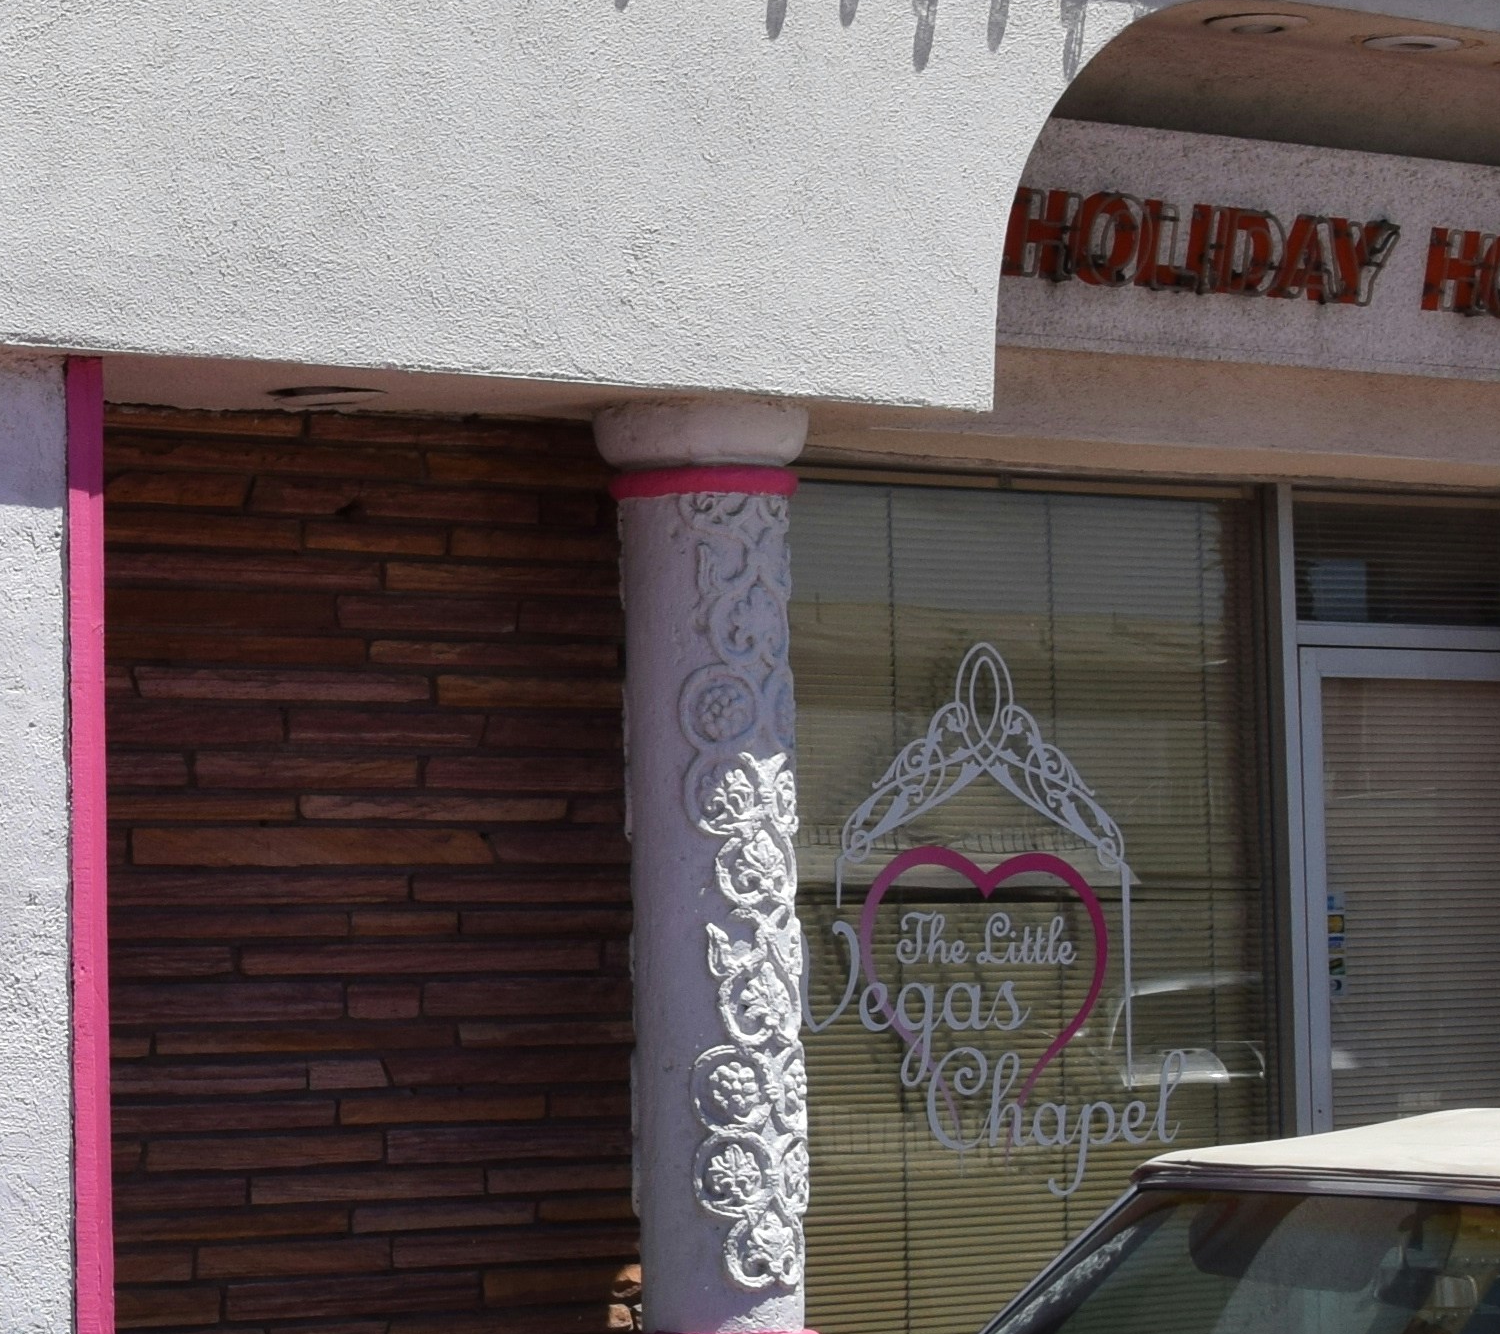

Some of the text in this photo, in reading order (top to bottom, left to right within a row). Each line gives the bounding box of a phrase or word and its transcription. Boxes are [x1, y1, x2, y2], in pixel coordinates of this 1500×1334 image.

[1002, 186, 1400, 307] HOLIDAY
[800, 920, 1031, 1087] Vegas
[896, 910, 1076, 965] The Little
[926, 1046, 1186, 1197] Chapel
